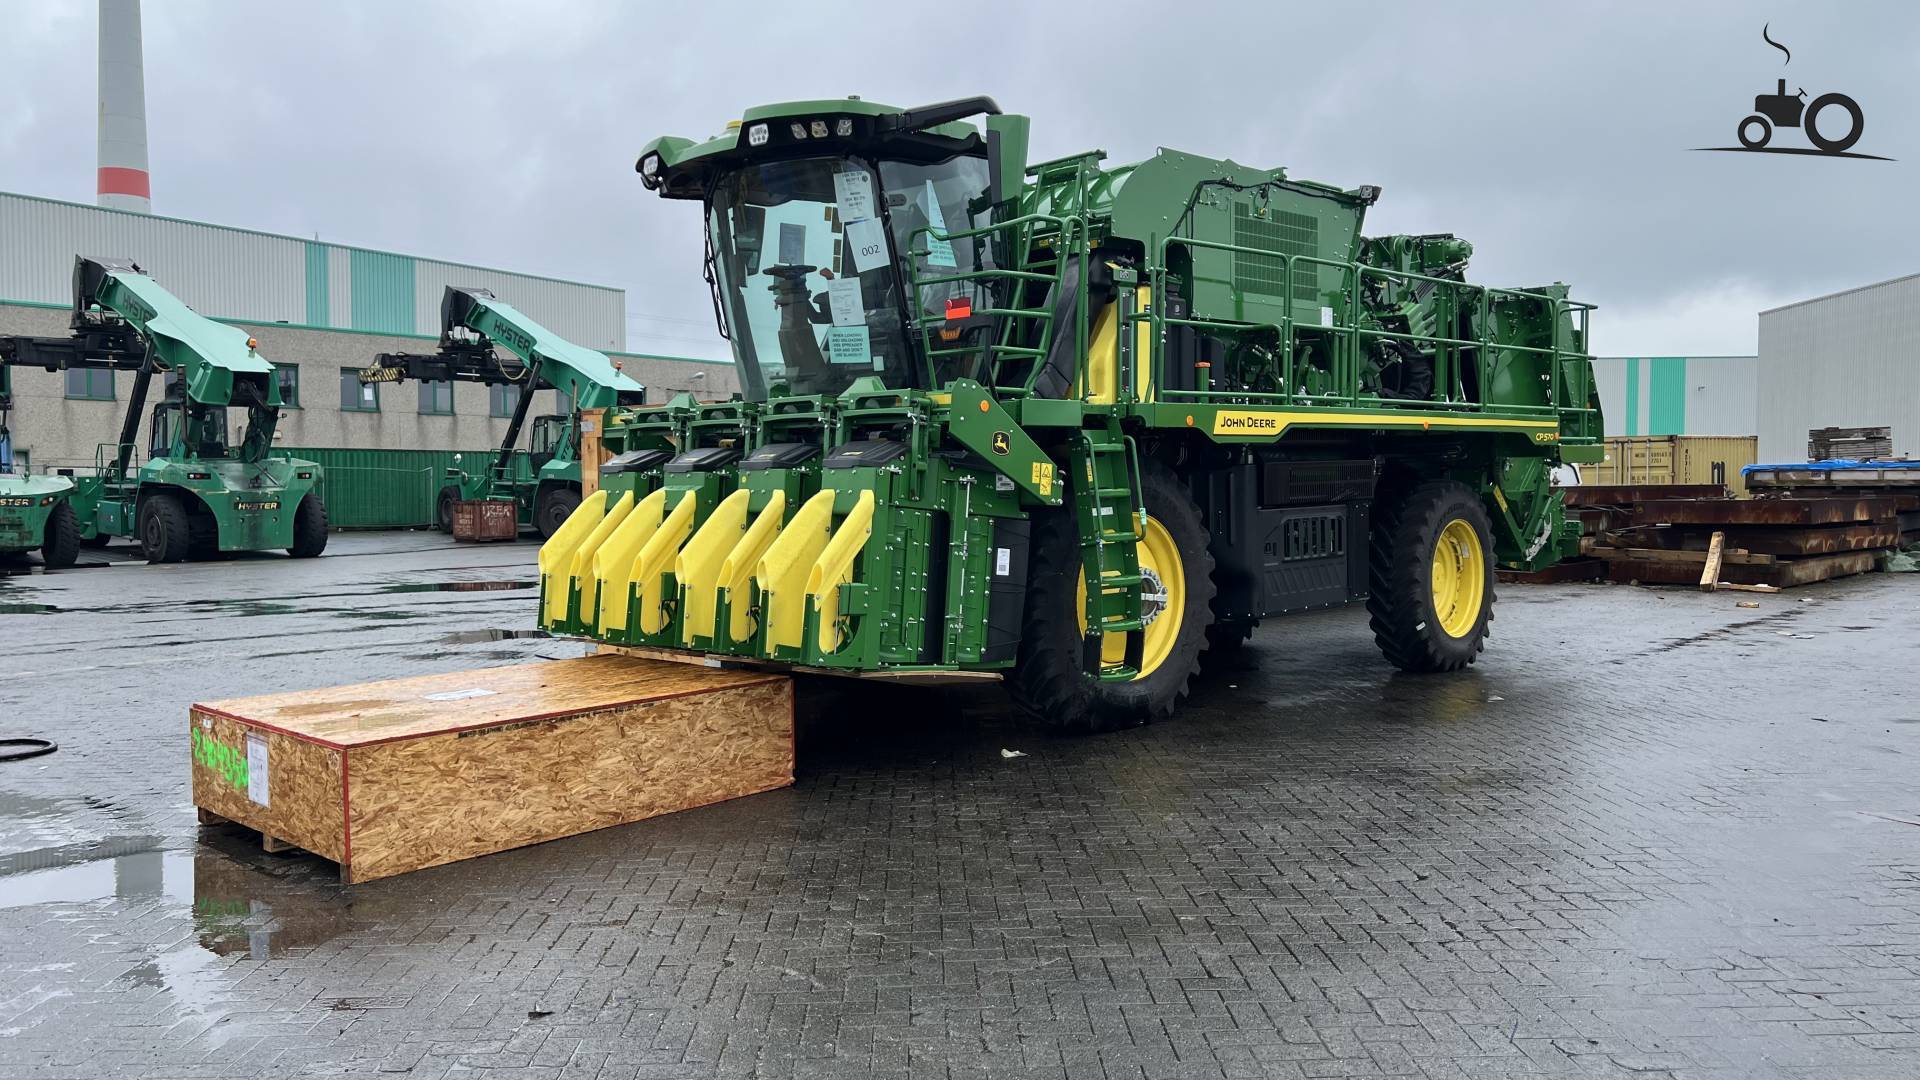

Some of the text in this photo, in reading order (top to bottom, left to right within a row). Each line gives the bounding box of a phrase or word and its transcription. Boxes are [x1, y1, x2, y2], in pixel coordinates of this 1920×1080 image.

[862, 245, 880, 256] 002
[494, 319, 531, 353] HYSTER
[1221, 416, 1276, 428] JOHN DEERE
[238, 502, 278, 510] HYSTER
